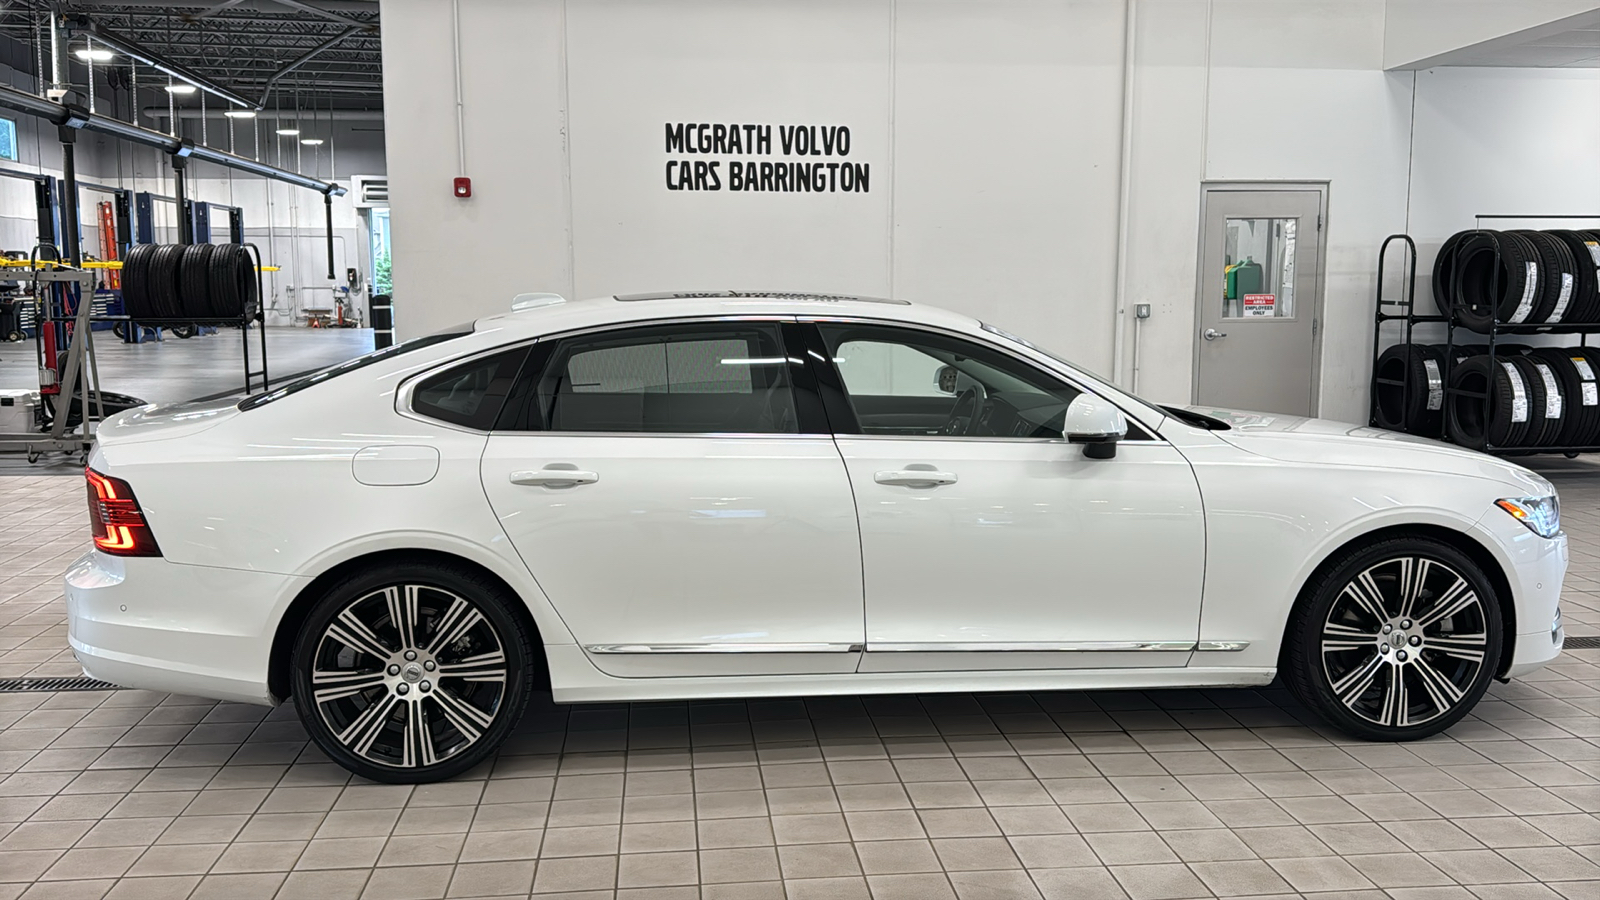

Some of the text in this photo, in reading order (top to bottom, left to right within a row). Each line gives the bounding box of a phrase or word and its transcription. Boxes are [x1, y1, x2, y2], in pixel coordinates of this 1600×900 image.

[665, 123, 850, 156] MCGRATH VOLVO
[666, 160, 870, 193] CARS BARRINGTON
